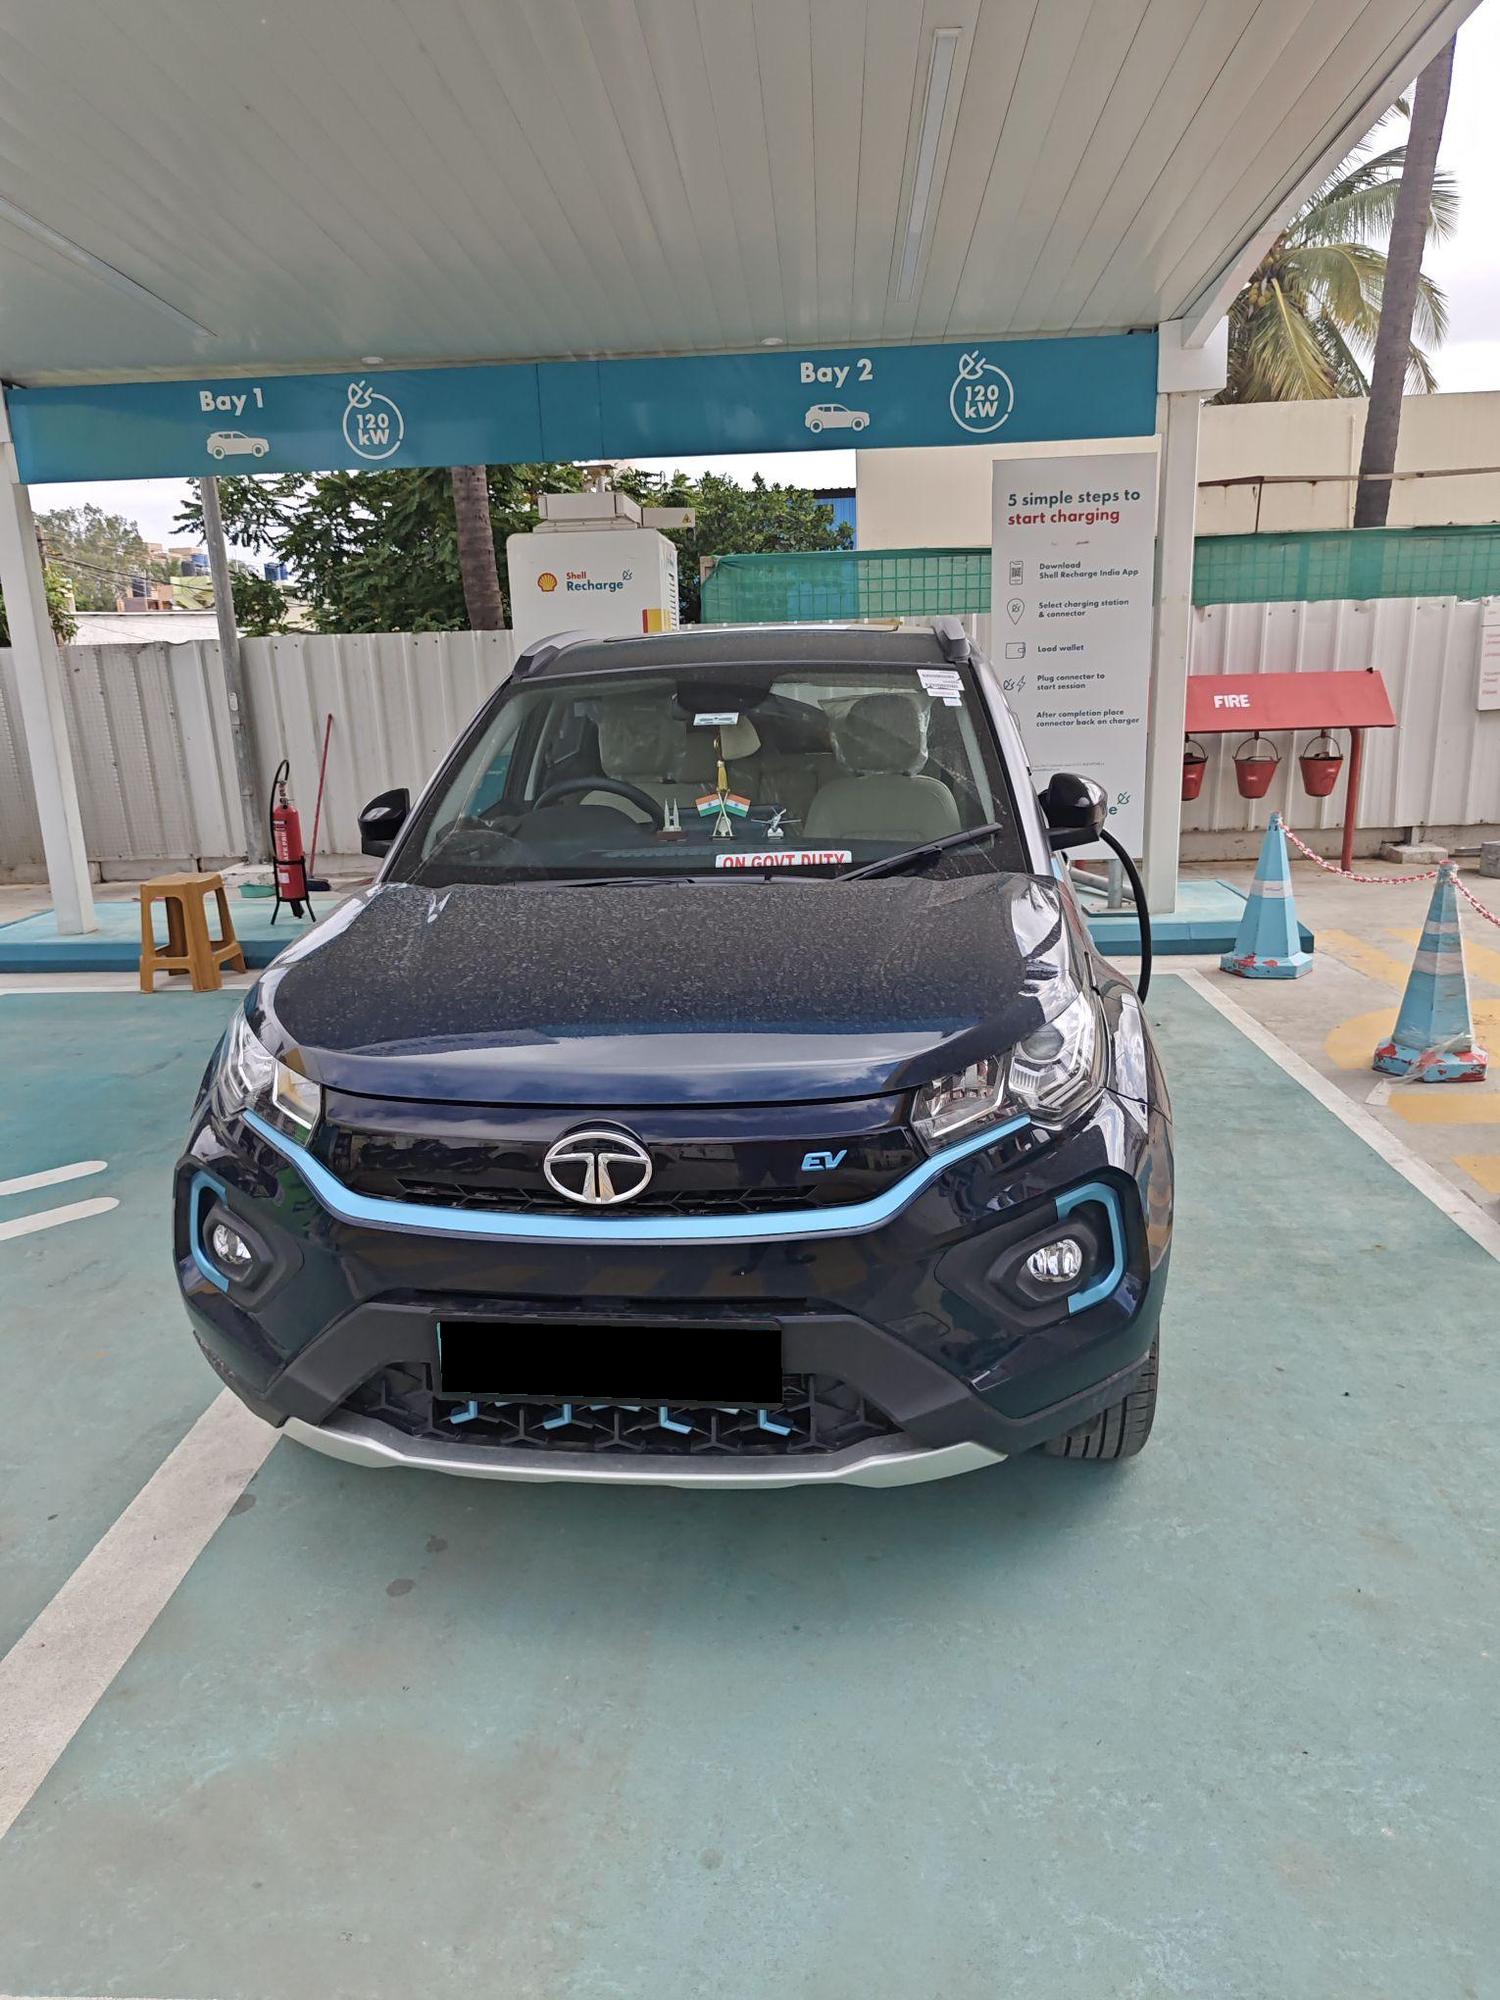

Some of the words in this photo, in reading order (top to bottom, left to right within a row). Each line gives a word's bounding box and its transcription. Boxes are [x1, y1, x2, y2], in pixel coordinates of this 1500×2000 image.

[800, 362, 850, 388] Bay
[856, 358, 874, 381] 2
[965, 384, 999, 401] 120
[200, 390, 247, 416] Bay
[253, 387, 264, 408] 1
[964, 400, 999, 418] kW
[356, 413, 389, 429] 120
[357, 428, 390, 445] kW
[1008, 493, 1017, 507] 5
[1022, 490, 1073, 508] simple
[1078, 489, 1120, 505] steps
[1124, 489, 1141, 501] to
[1008, 511, 1046, 526] start
[1050, 508, 1120, 525] charging
[1039, 561, 1081, 570] Download
[566, 571, 587, 580] Shell
[1060, 570, 1098, 578] Recharge
[1099, 569, 1120, 577] India
[1122, 568, 1139, 576] App
[566, 579, 624, 592] Recharge
[1039, 601, 1062, 609] Select
[1064, 600, 1099, 608] charging
[1037, 675, 1054, 683] Plug
[1057, 682, 1086, 690] session
[1213, 694, 1250, 708] FIRE
[1058, 710, 1102, 719] completion
[1103, 709, 1124, 717] place
[1036, 720, 1074, 728] connector
[1109, 718, 1140, 726] charger
[722, 857, 746, 868] ON
[750, 855, 796, 868] GOVT
[801, 853, 845, 865] DUTY
[801, 1150, 847, 1171] EV
